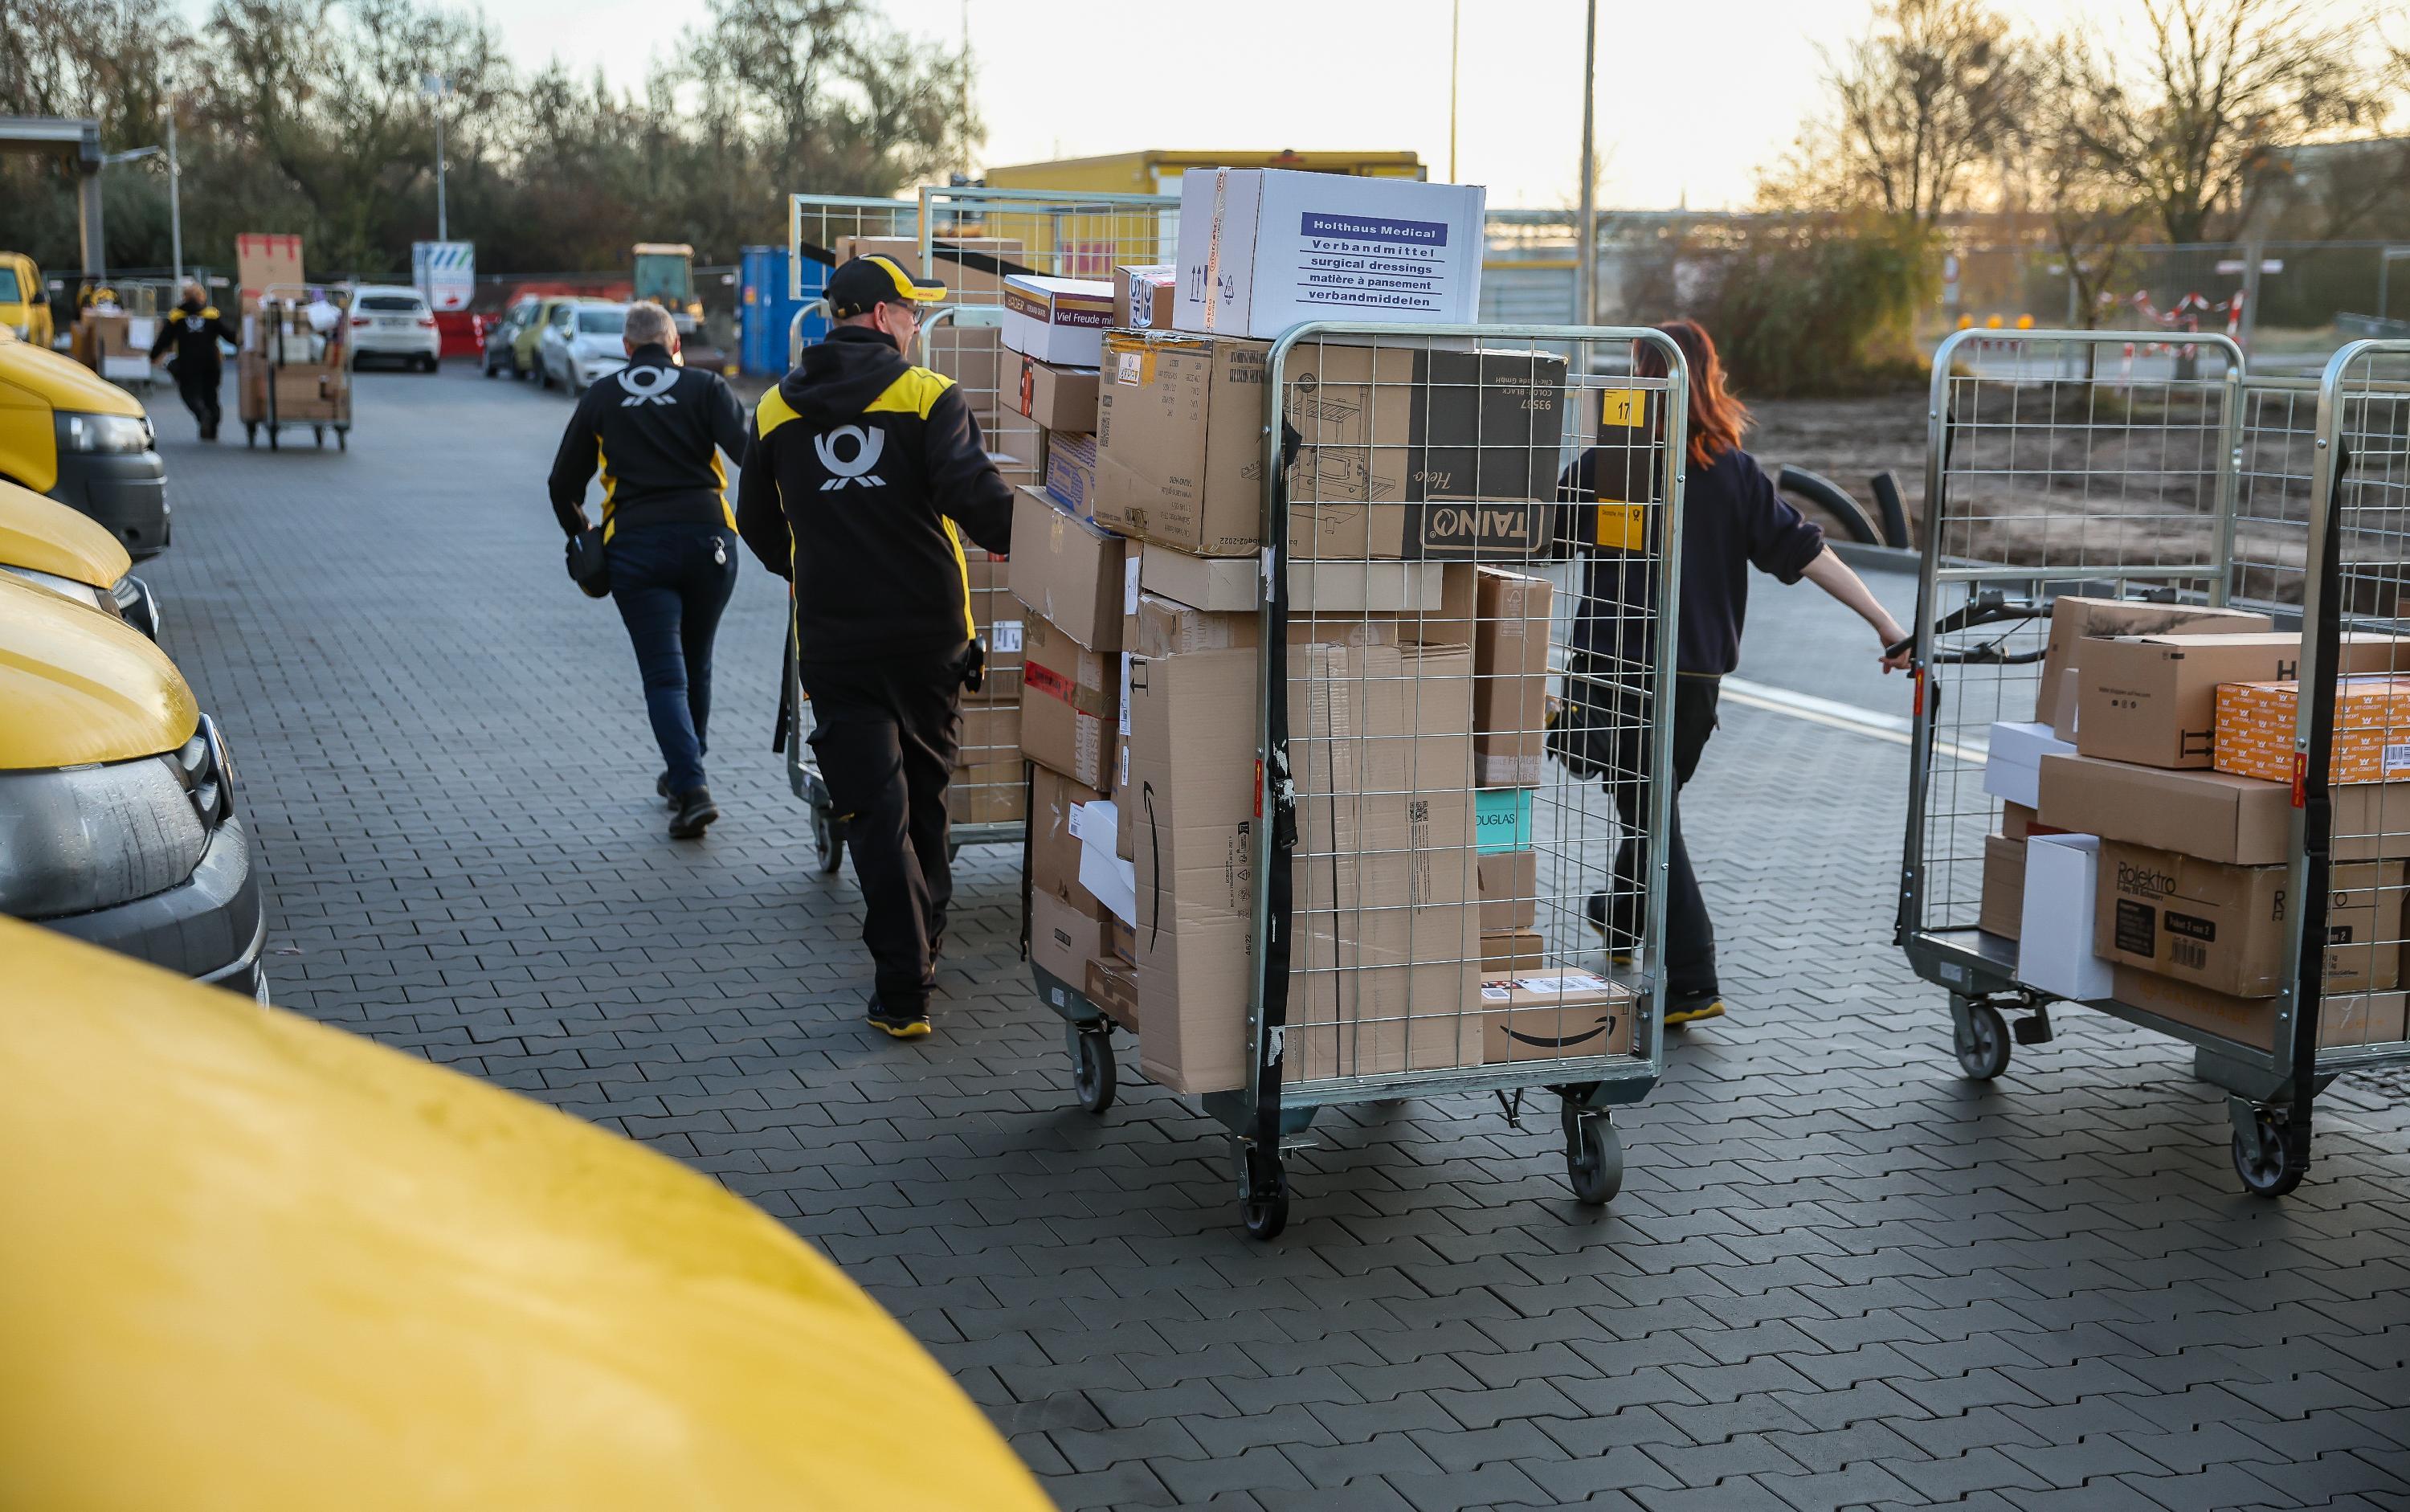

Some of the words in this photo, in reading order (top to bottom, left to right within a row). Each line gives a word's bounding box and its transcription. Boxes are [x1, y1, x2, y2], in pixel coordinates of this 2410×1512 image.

[1313, 220, 1377, 234] Holthaus
[1381, 226, 1436, 239] Medical
[1313, 240, 1434, 257] Verbandmittel
[1311, 258, 1364, 269] surgical
[1369, 260, 1432, 275] dressings
[1309, 274, 1354, 284] matière
[1358, 276, 1364, 285] à
[1367, 280, 1432, 290] pansement
[1007, 296, 1024, 311] BADER
[1309, 290, 1430, 306] verbandmiddelen
[1056, 311, 1072, 322] Viel
[1073, 313, 1100, 325] Freude
[1496, 376, 1517, 384] GmbH
[1502, 387, 1525, 395] BLACK
[1618, 402, 1630, 420] 17
[1413, 471, 1452, 489] Hero
[1433, 509, 1527, 537] TAINO
[1476, 814, 1515, 826] OUGLAS
[2118, 861, 2176, 894] Rolektro
[2204, 926, 2211, 936] 2
[2341, 931, 2347, 941] 2
